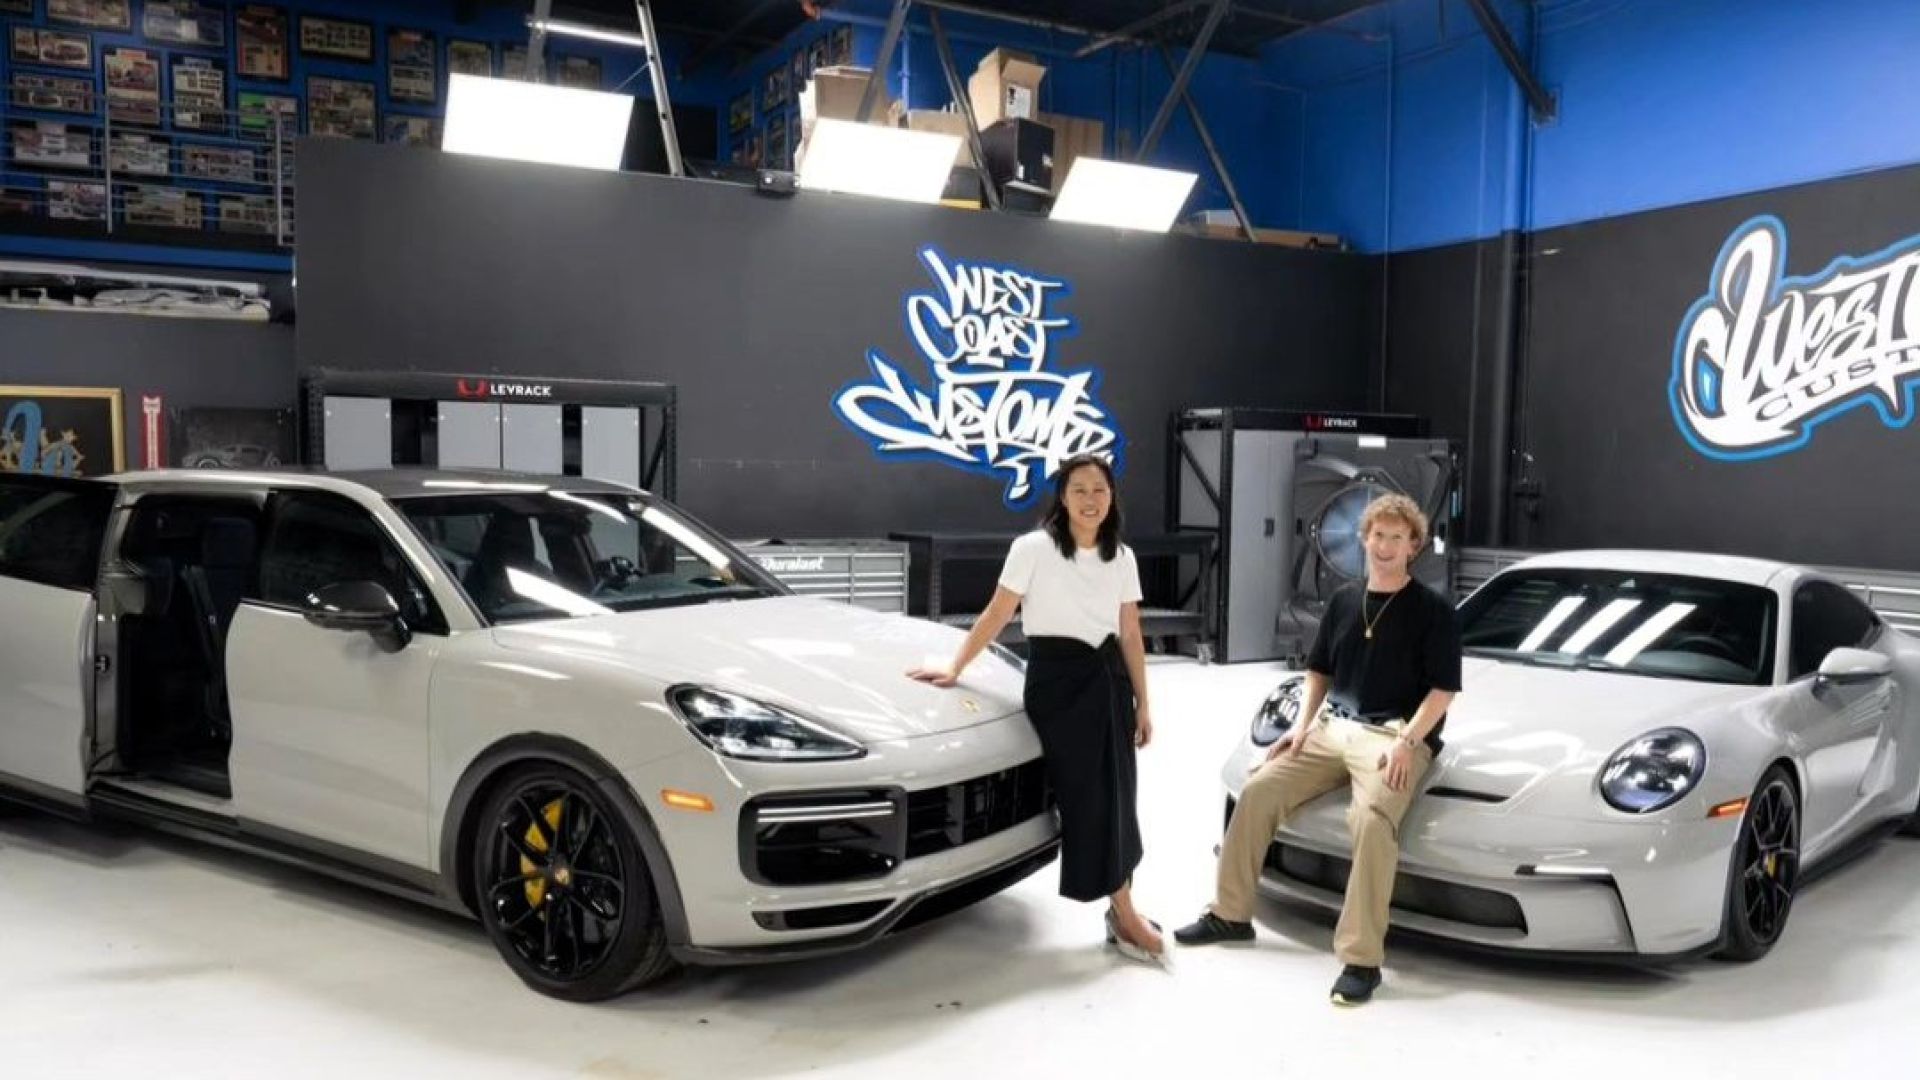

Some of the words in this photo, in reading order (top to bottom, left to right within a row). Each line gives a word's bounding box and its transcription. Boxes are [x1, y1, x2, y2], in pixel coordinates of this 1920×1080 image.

[923, 249, 1062, 319] WEST
[908, 296, 1068, 373] COAST
[490, 384, 552, 396] LEVRACK
[1754, 343, 1920, 421] CUST
